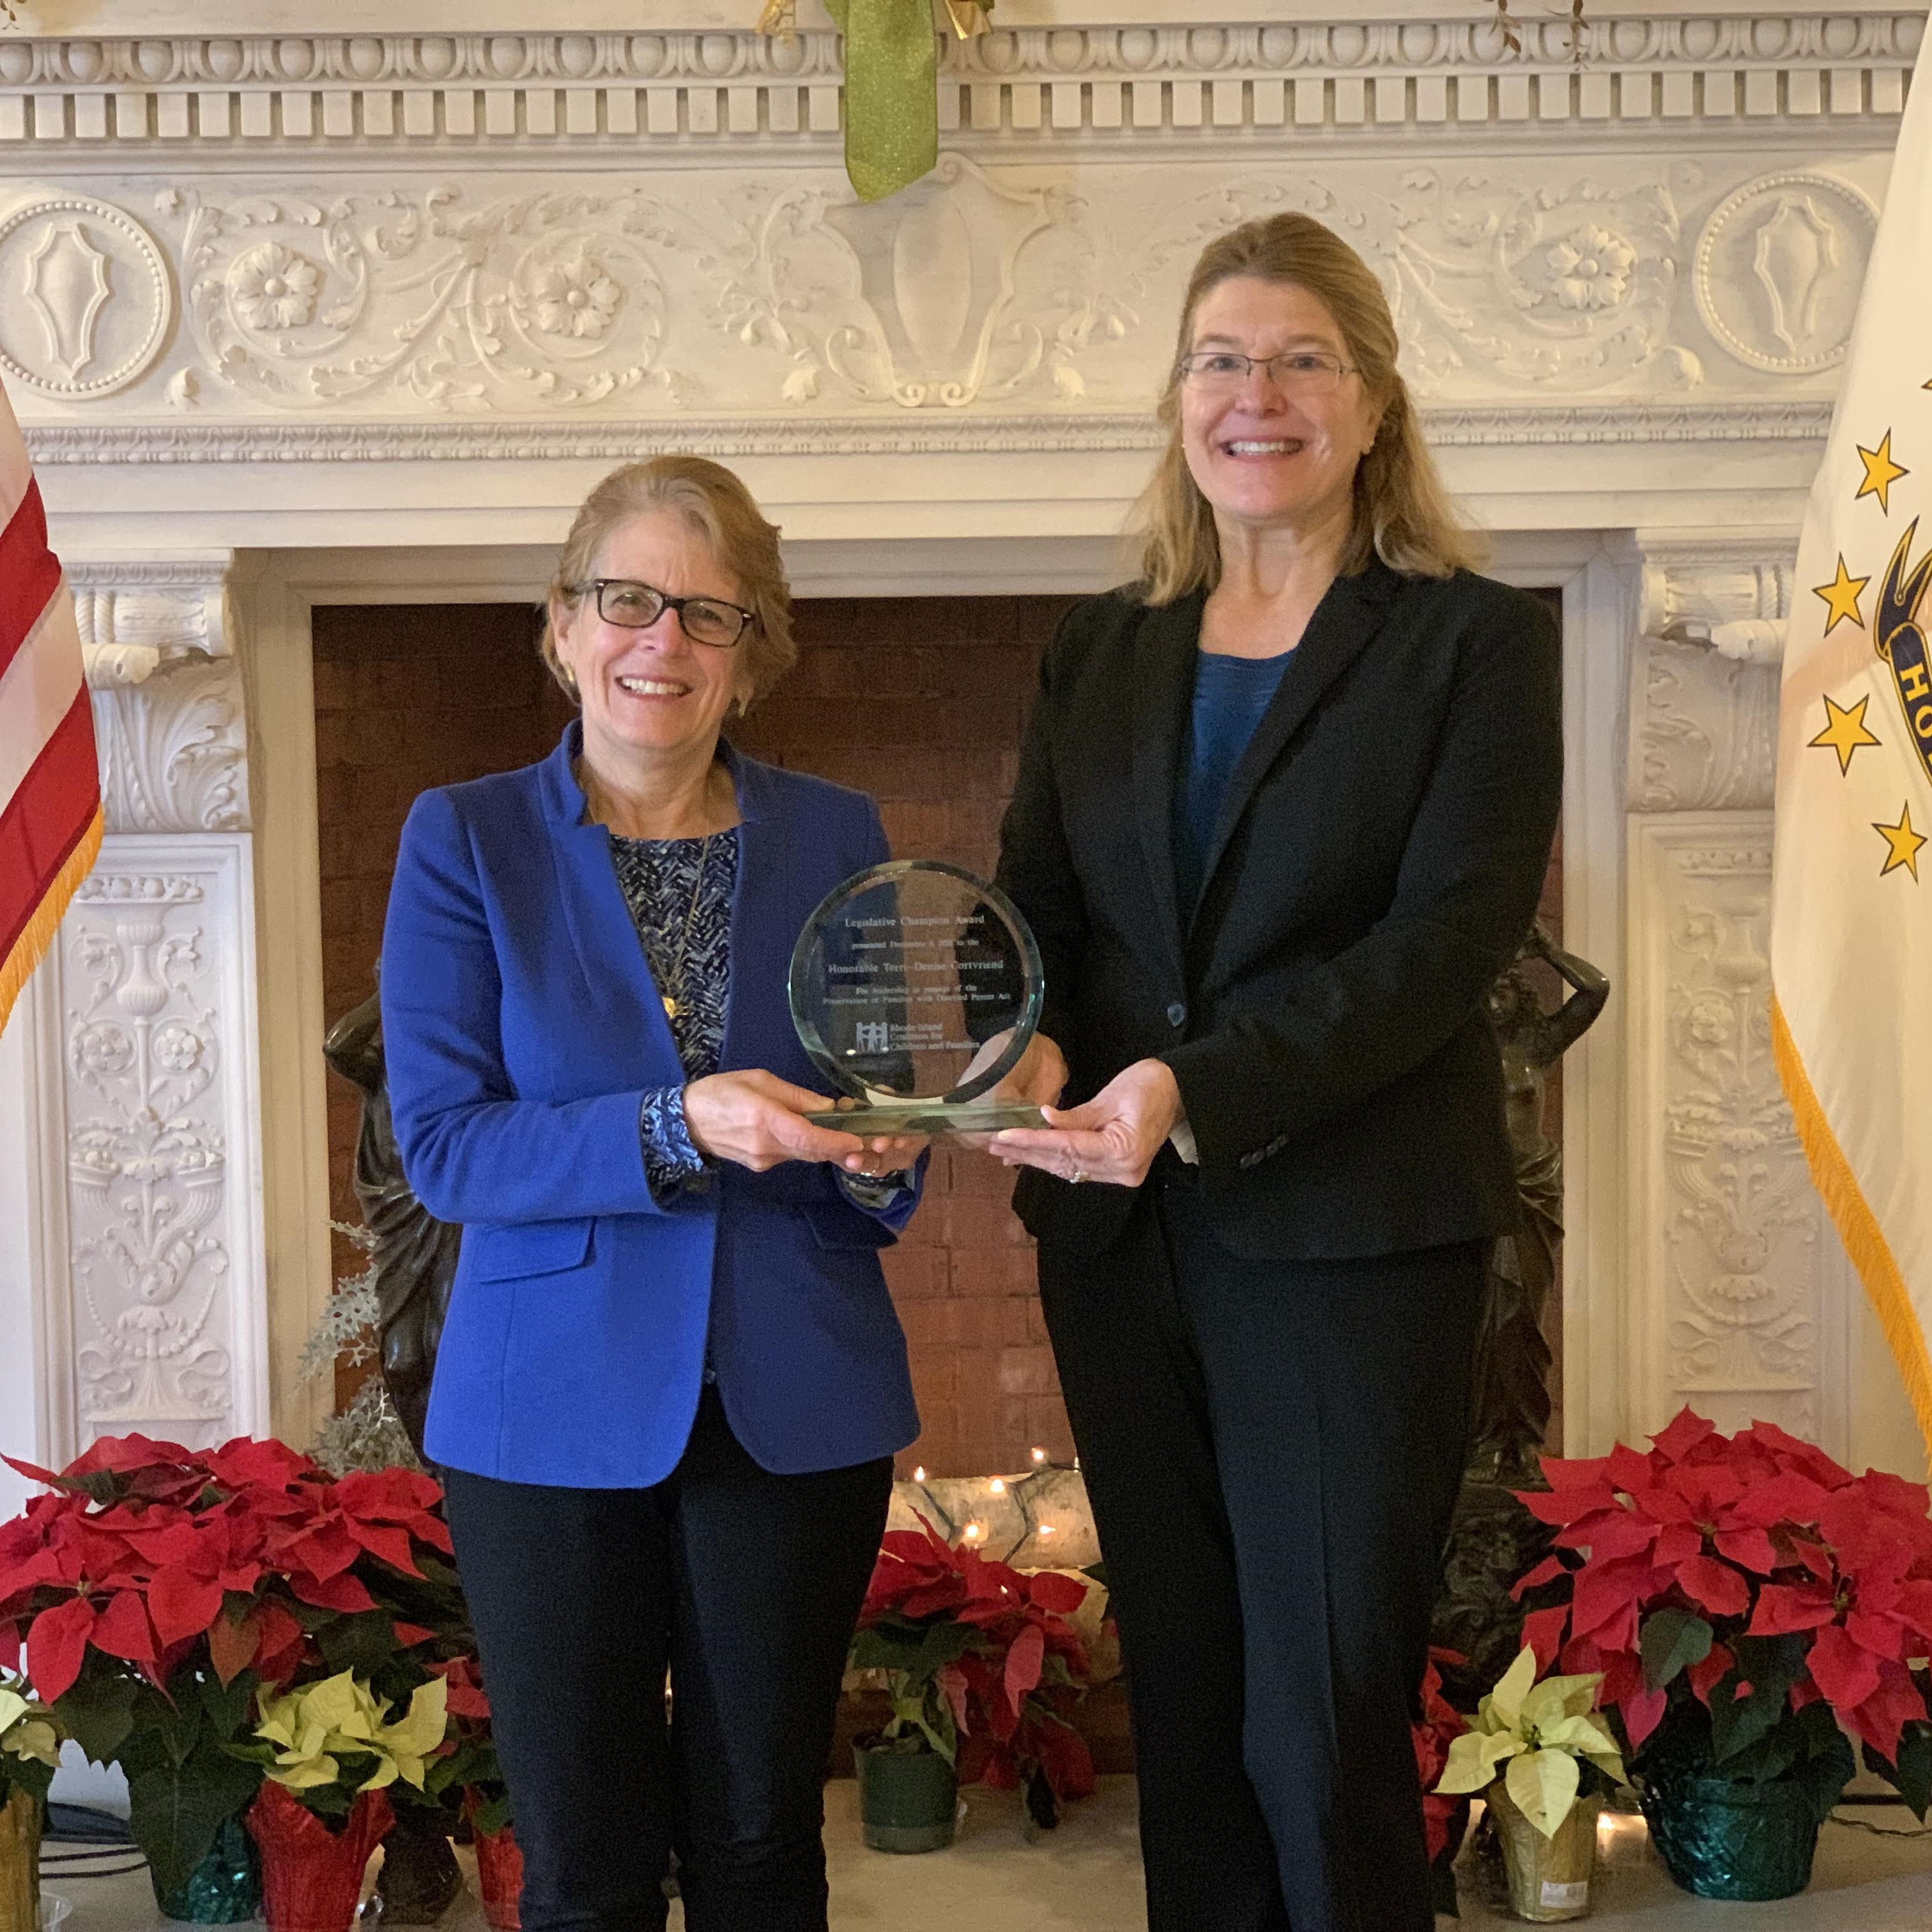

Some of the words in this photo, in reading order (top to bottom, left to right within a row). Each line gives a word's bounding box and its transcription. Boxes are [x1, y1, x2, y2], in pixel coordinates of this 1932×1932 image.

[1899, 662, 1932, 765] HO
[845, 918, 896, 928] Legislative
[900, 916, 949, 926] Champion
[955, 915, 985, 924] Award
[829, 963, 878, 974] Honorable
[951, 960, 1004, 970] Cortvriend
[890, 1023, 916, 1032] Rhode
[919, 1023, 943, 1031] Island
[890, 1042, 926, 1050] Children
[928, 1041, 944, 1050] and
[946, 1041, 980, 1049] Families
